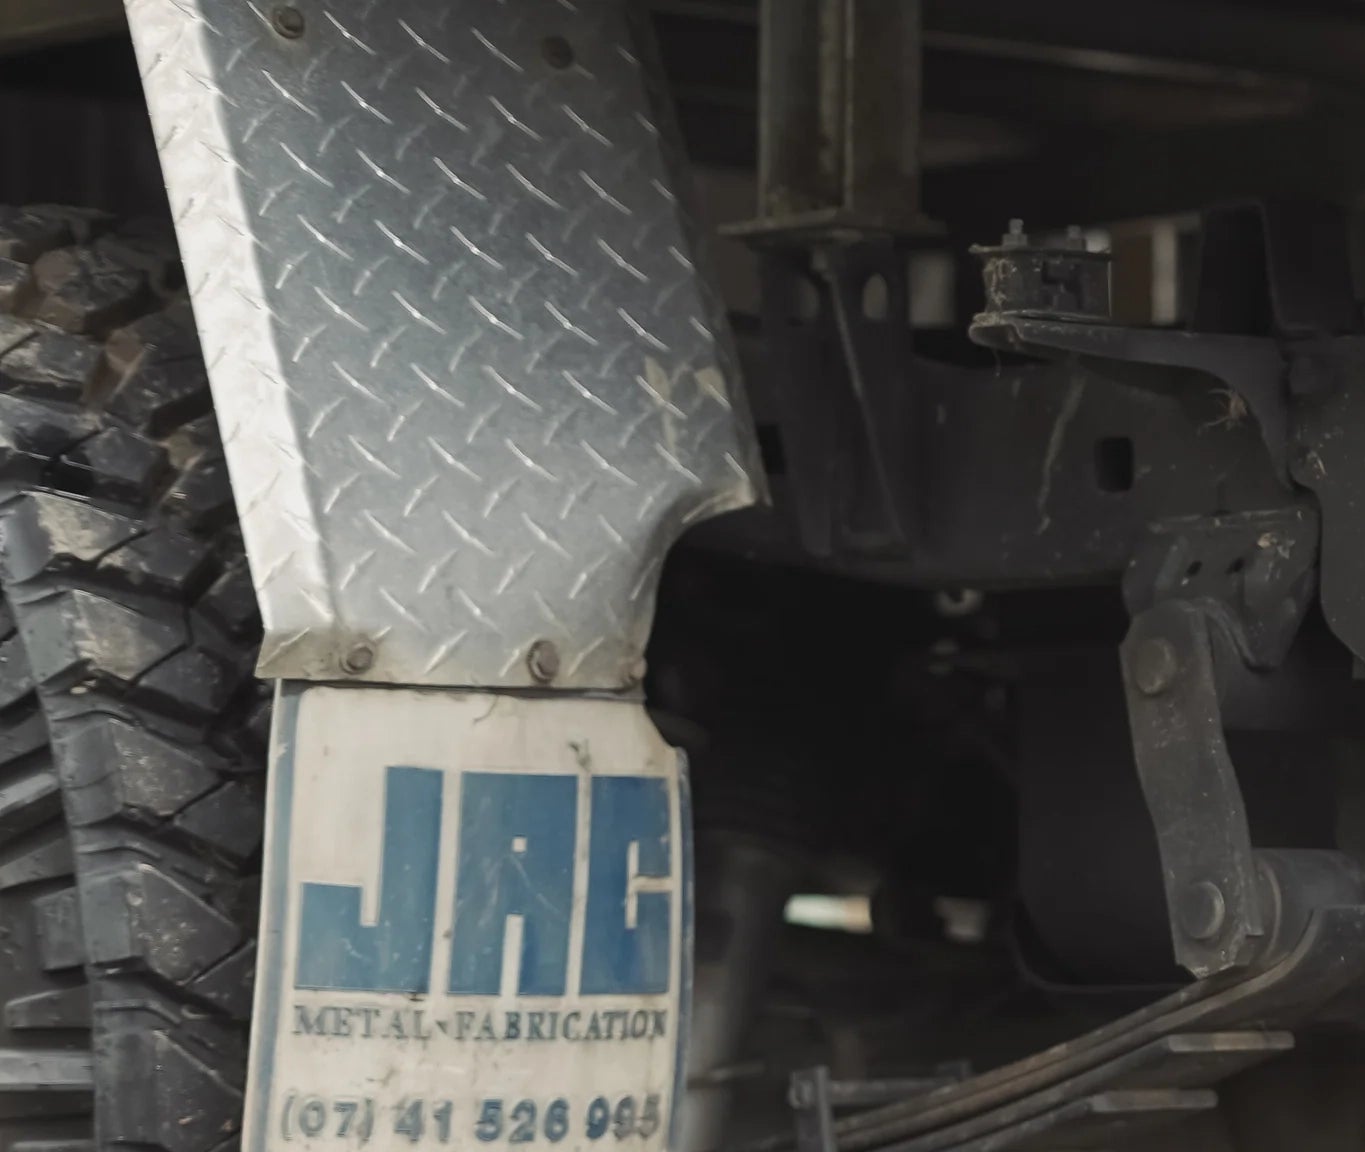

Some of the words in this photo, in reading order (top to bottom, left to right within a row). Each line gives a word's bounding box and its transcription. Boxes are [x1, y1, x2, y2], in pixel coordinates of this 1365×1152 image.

[294, 766, 672, 996] JAC
[292, 1005, 432, 1040] METAL
[455, 1008, 669, 1042] FABRICATION
[281, 1096, 374, 1142] (07)
[394, 1099, 453, 1143] 41
[475, 1098, 570, 1144] 526
